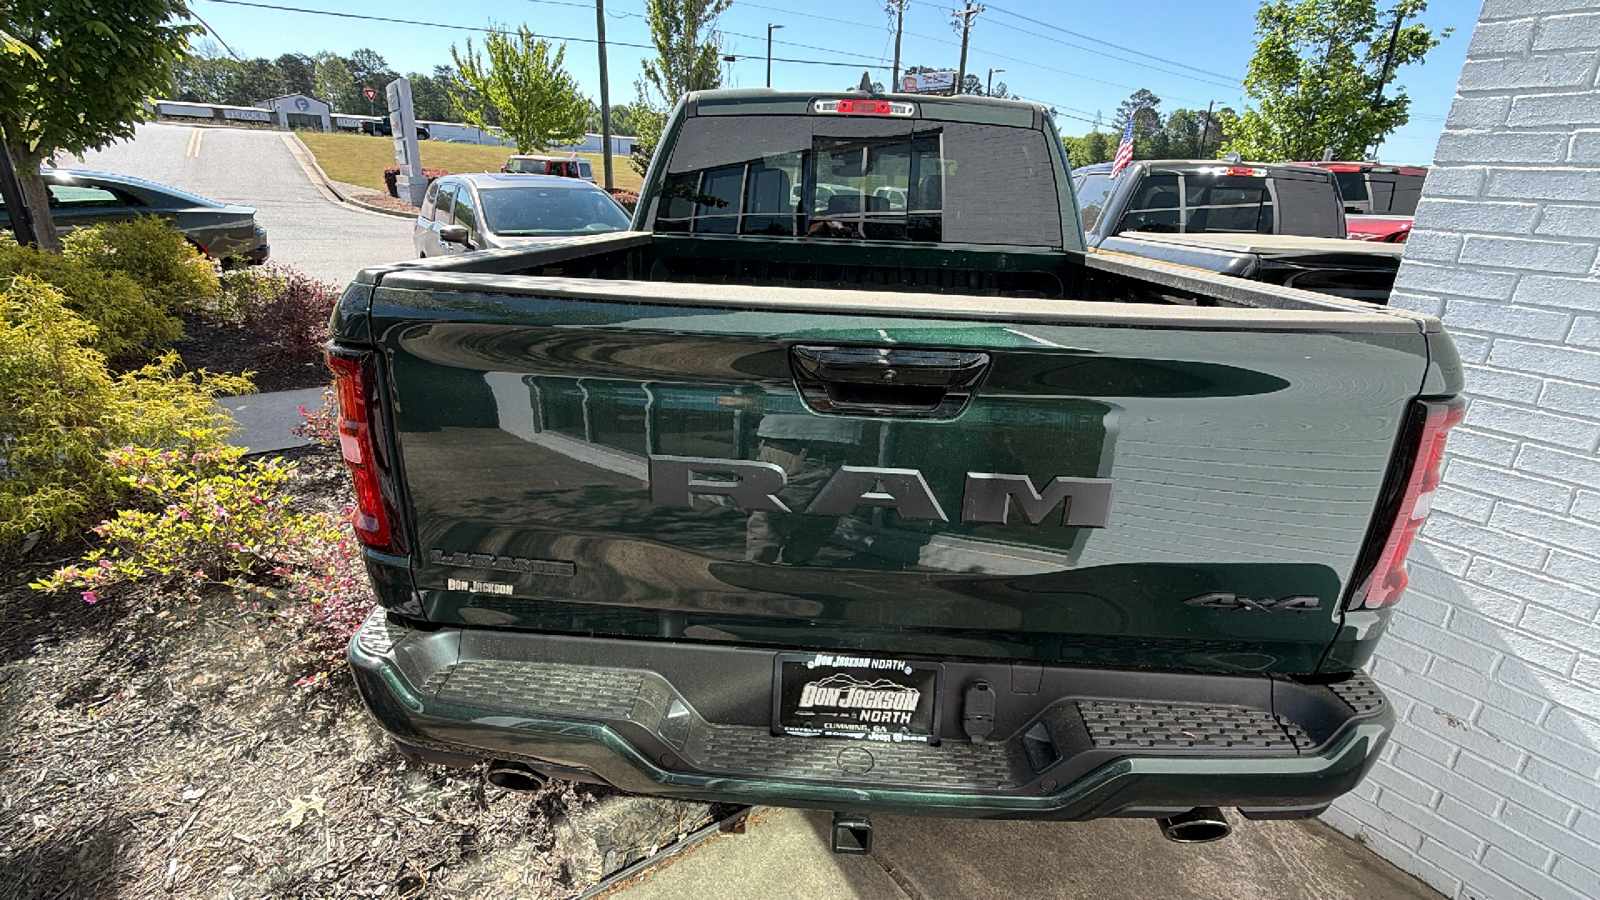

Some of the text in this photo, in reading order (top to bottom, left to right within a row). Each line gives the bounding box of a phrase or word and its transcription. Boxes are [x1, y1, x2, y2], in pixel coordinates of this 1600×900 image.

[649, 454, 1114, 528] RAM
[429, 549, 576, 577] LARAMIE
[448, 578, 514, 595] DON JACKSON
[815, 654, 905, 671] DON JACKSON NORTH
[799, 685, 920, 711] DON JACKSON
[860, 711, 911, 724] NORTH
[873, 725, 887, 733] GA
